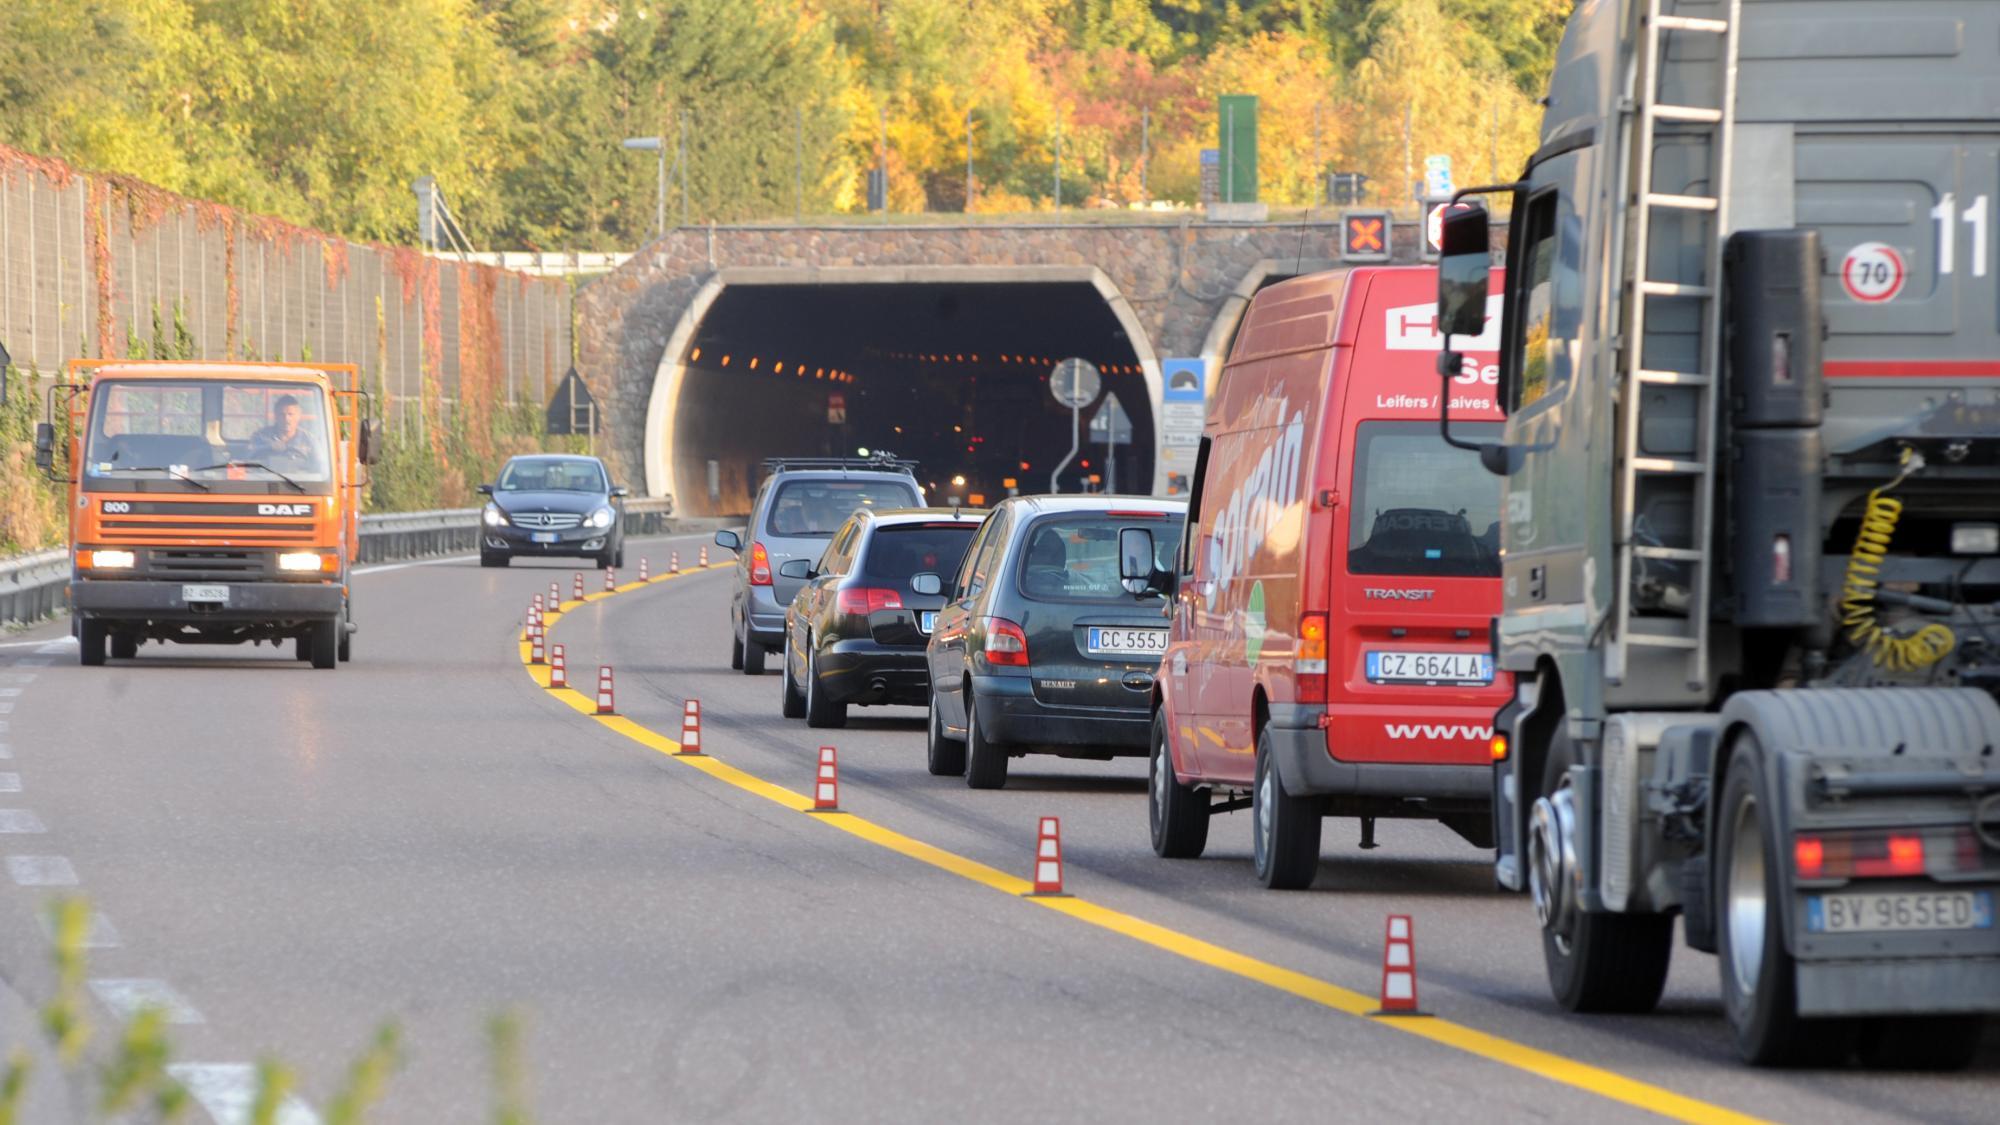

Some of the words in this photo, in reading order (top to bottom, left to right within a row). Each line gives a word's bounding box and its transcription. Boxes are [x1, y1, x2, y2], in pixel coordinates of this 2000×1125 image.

[1930, 192, 1988, 278] 11
[1859, 262, 1888, 285] 70
[1377, 395, 1429, 409] Leifers
[1432, 396, 1439, 409] /
[1446, 396, 1490, 409] aives
[104, 501, 130, 513] 800
[258, 503, 312, 516] DAF
[1363, 588, 1436, 601] TRANSIT
[1102, 631, 1120, 648] CC
[1127, 632, 1167, 649] 555J
[1381, 655, 1407, 676] CZ
[1415, 656, 1480, 678] 664LA
[1041, 679, 1076, 689] RENAULT
[1828, 897, 1865, 928] BV
[1874, 895, 1971, 927] 965ED
